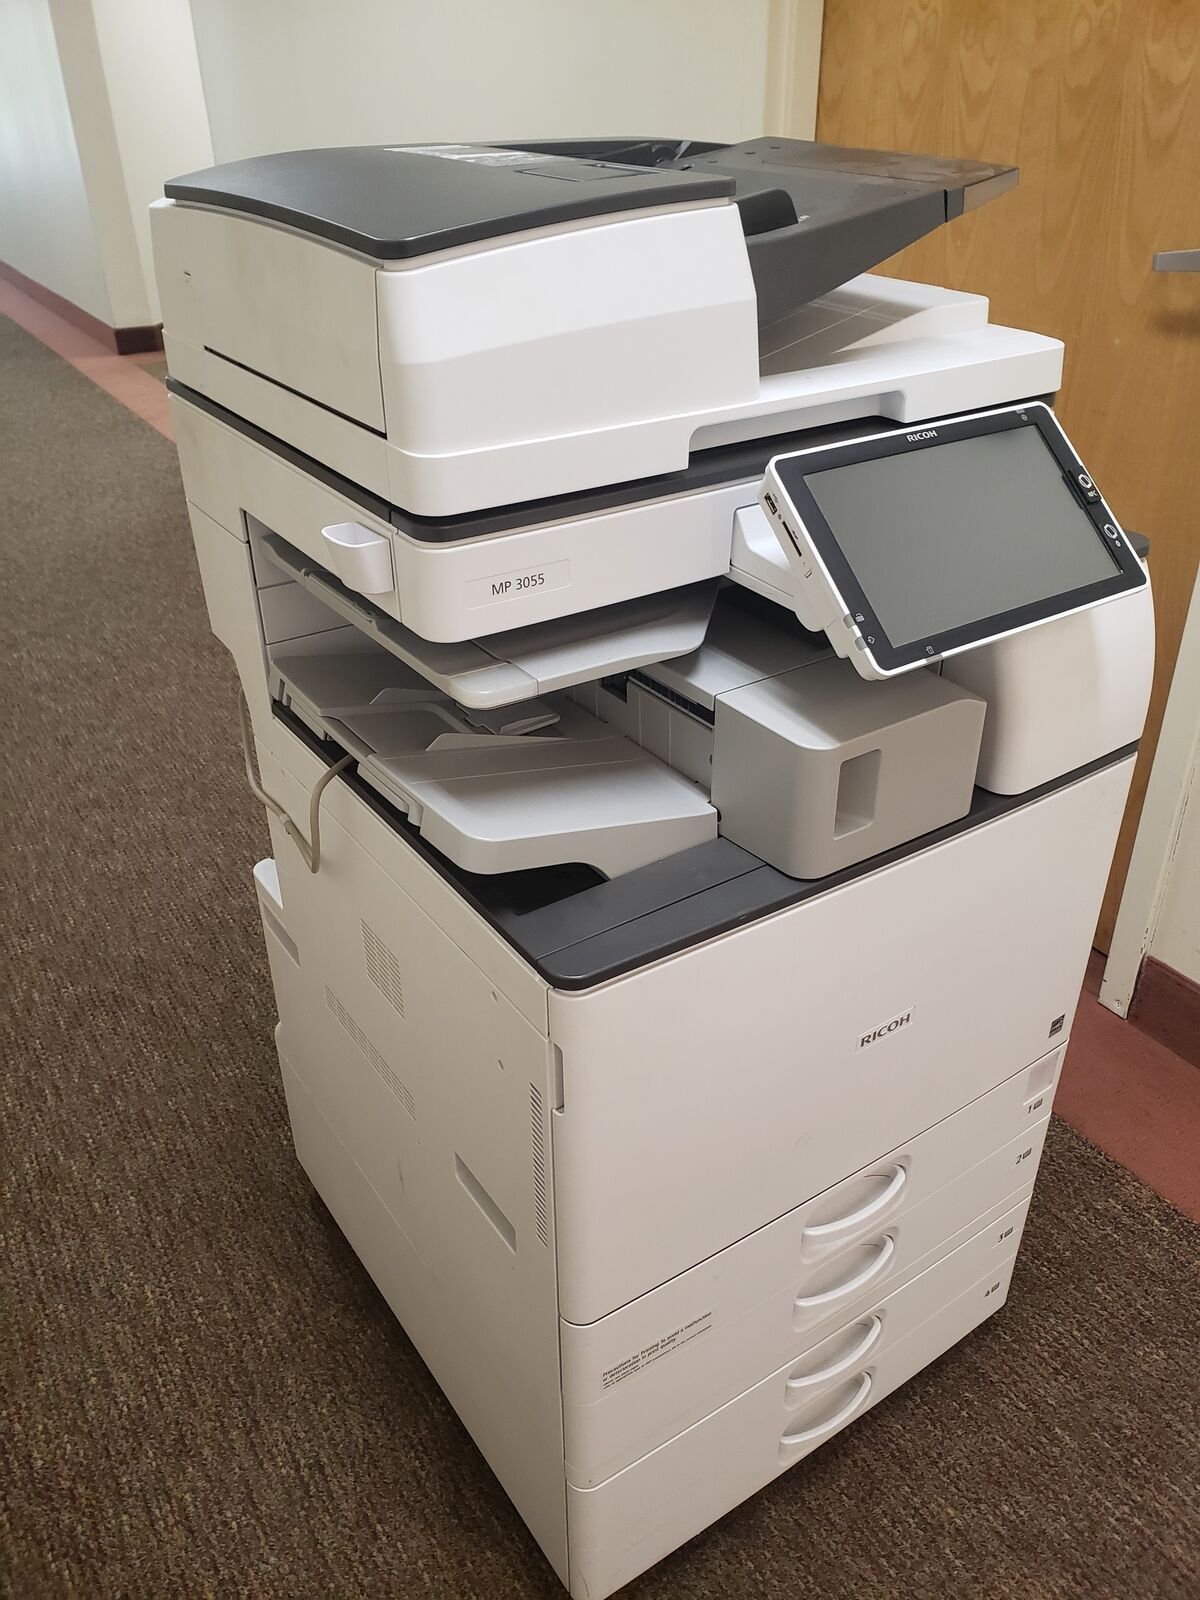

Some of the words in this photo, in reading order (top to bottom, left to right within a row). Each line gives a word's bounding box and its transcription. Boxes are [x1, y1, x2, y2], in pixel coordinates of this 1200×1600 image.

[906, 430, 938, 441] RICOH
[491, 581, 512, 595] MP
[516, 573, 545, 590] 3055
[860, 1013, 910, 1047] RICOH
[1016, 1154, 1022, 1165] 2
